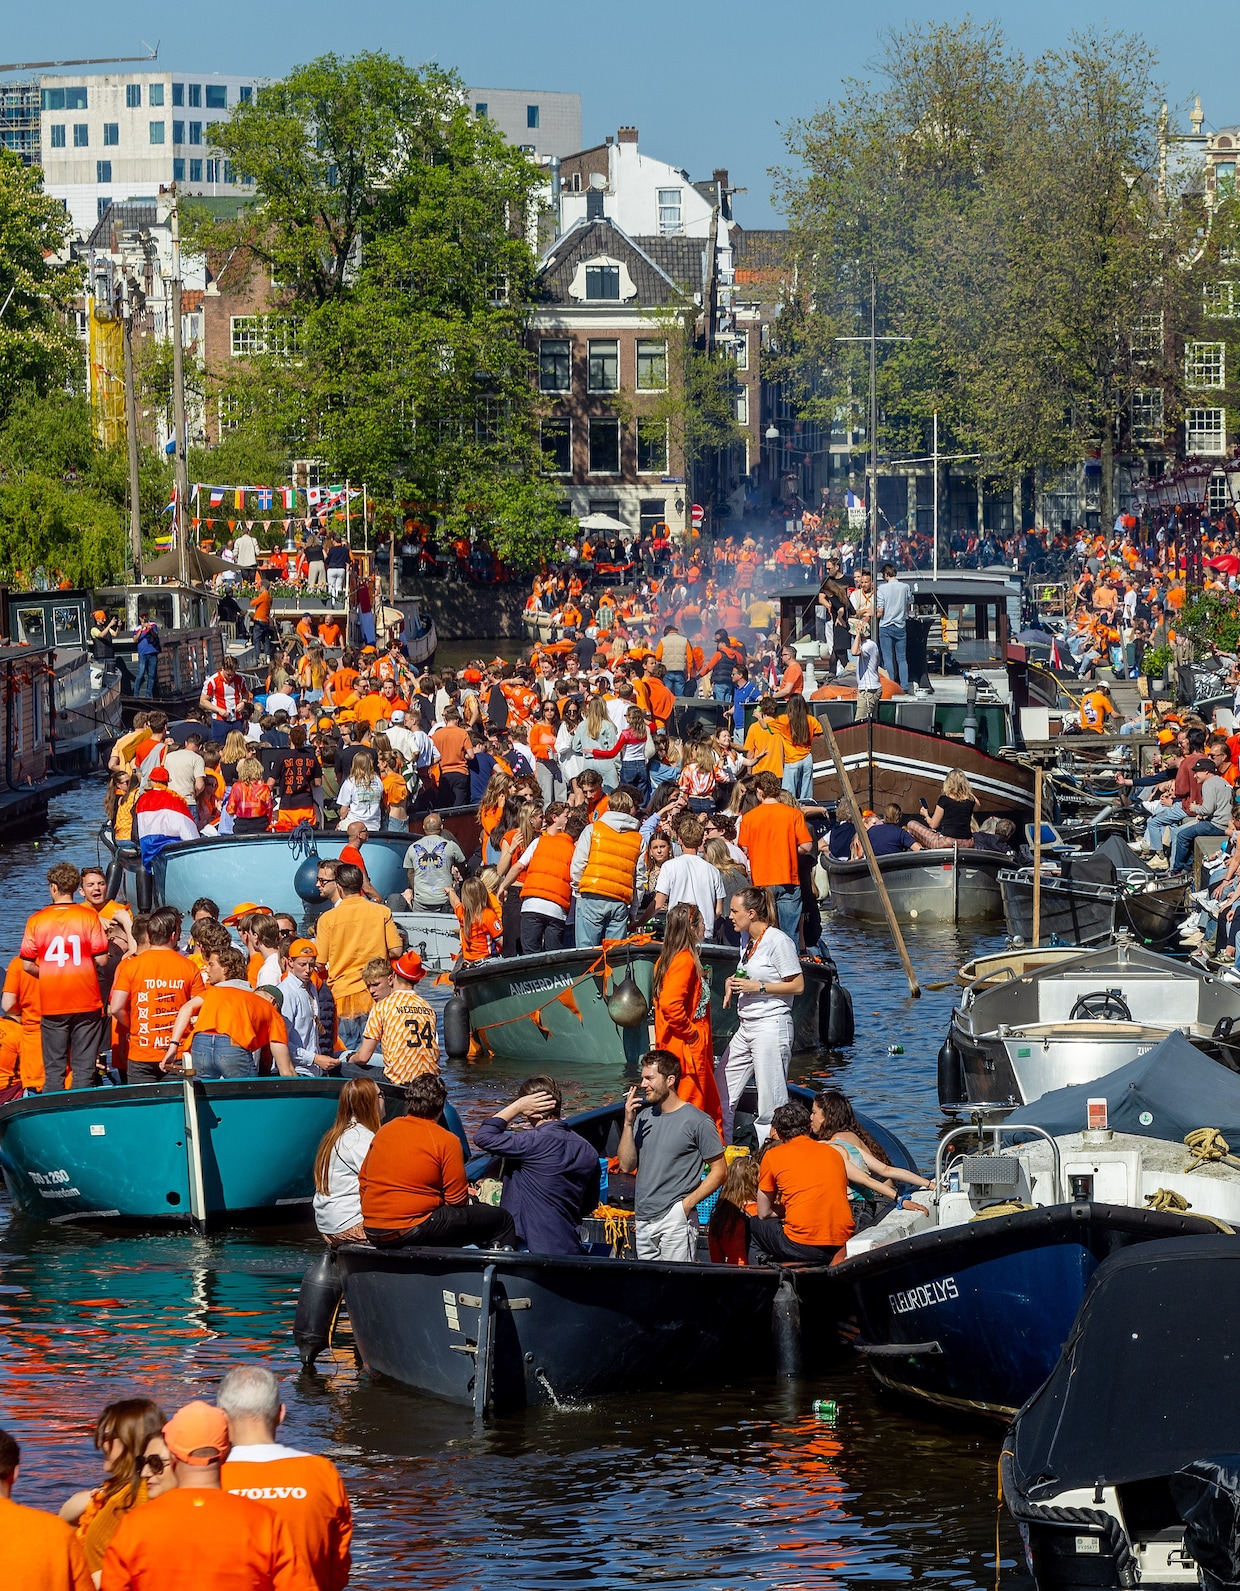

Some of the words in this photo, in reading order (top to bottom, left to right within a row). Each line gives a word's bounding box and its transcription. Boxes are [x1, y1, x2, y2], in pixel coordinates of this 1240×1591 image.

[339, 674, 353, 690] 14
[44, 934, 82, 967] 41
[144, 979, 155, 990] TO
[168, 979, 185, 990] LIST
[509, 972, 574, 996] AMSTERDAM
[405, 1020, 433, 1049] 34
[47, 1169, 71, 1184] 260
[38, 1186, 81, 1198] Amsterdam
